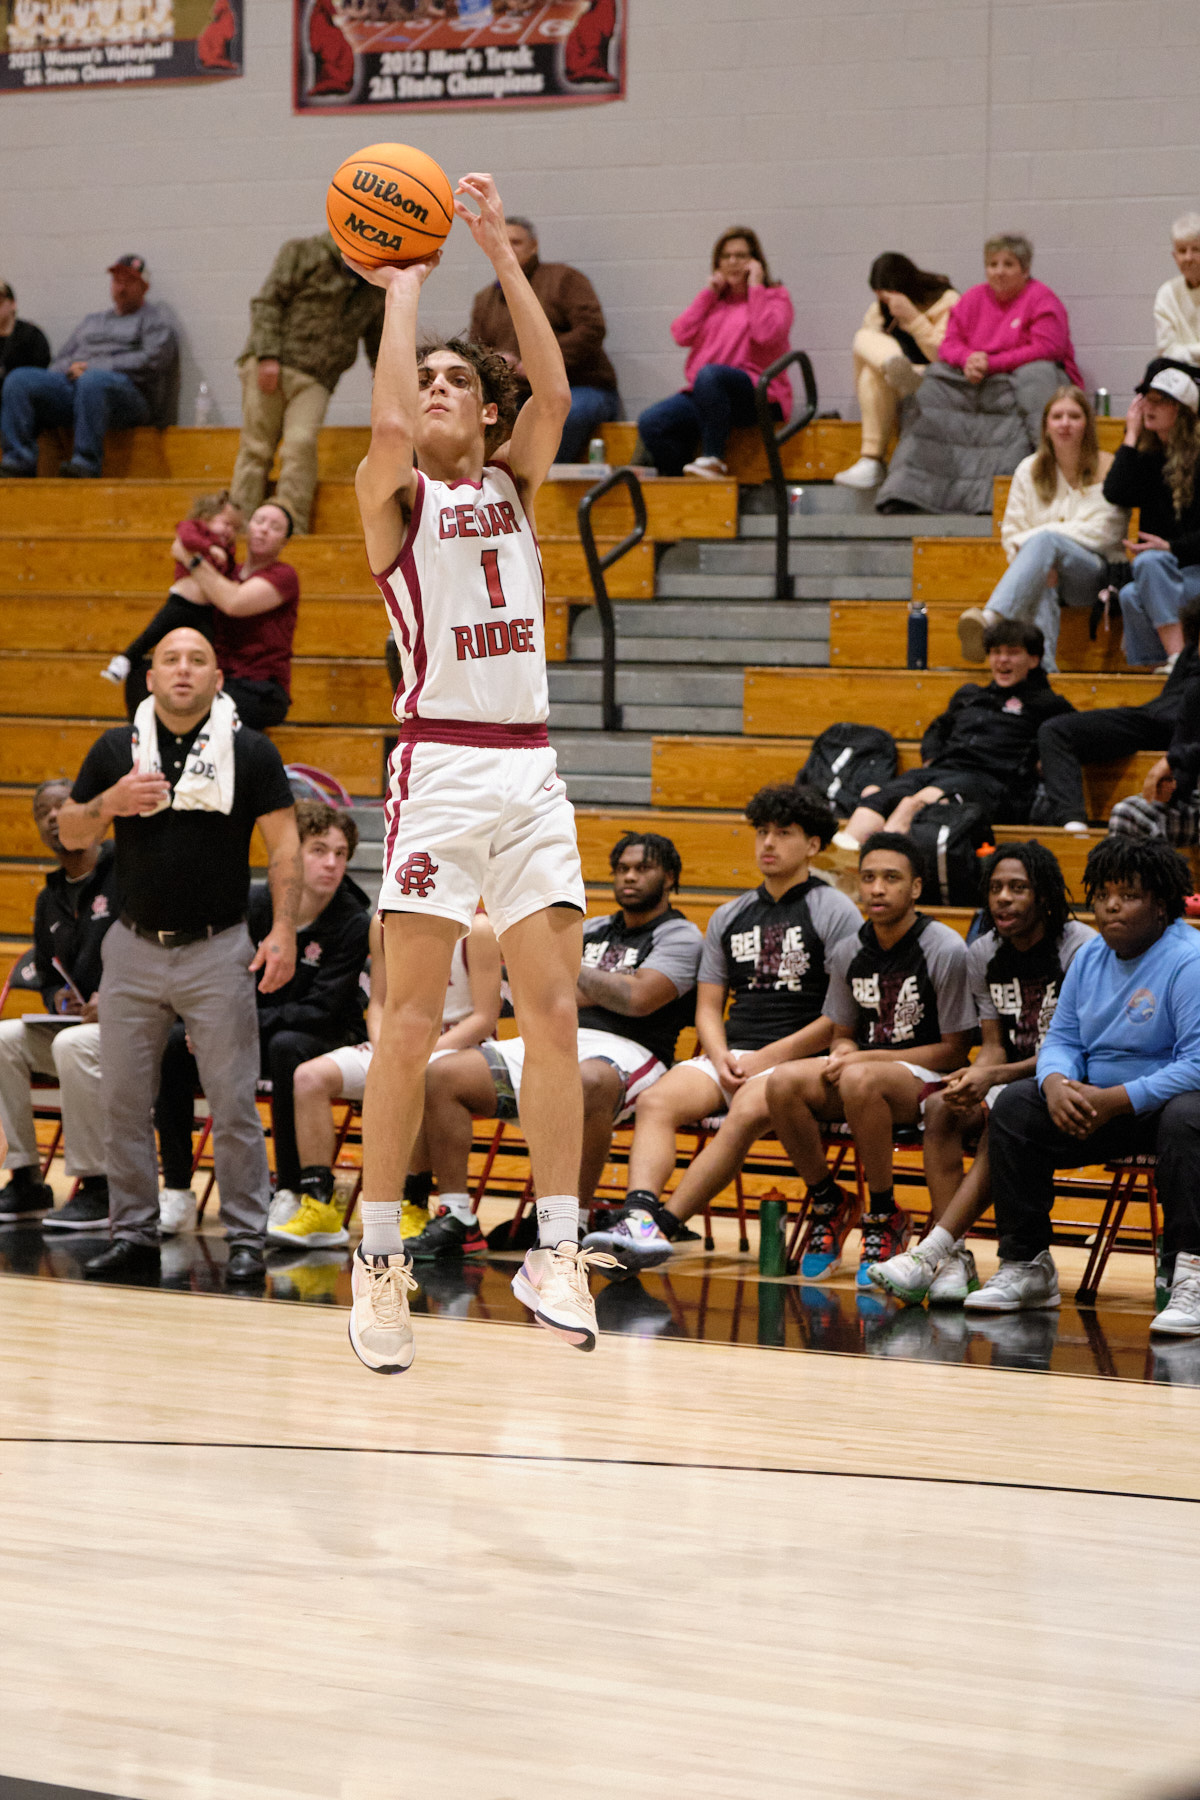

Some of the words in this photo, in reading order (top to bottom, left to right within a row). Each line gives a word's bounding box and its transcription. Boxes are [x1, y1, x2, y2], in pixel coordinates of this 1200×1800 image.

[104, 41, 173, 62] Volleyball
[380, 51, 426, 75] 2012
[428, 48, 483, 73] Men's
[485, 45, 534, 70] Track
[44, 66, 80, 84] State
[81, 63, 156, 82] Champions
[369, 76, 395, 100] 2A
[397, 75, 444, 98] State
[447, 70, 545, 99] Champions
[352, 169, 429, 224] Wilson
[345, 212, 403, 251] NCAA
[480, 549, 507, 609] 1
[451, 619, 536, 661] RIDGE
